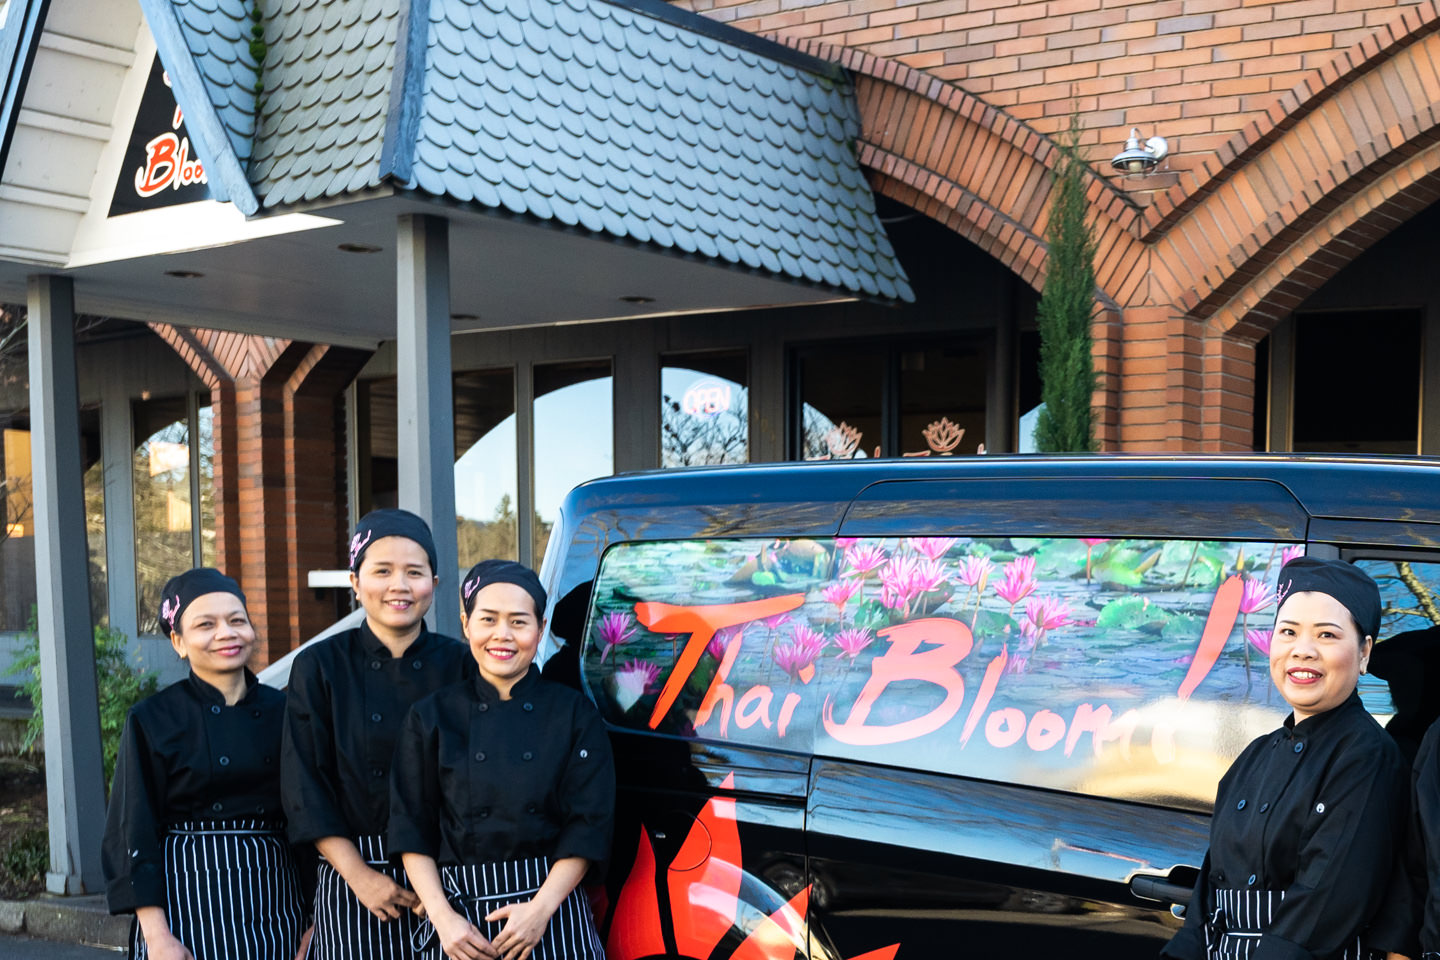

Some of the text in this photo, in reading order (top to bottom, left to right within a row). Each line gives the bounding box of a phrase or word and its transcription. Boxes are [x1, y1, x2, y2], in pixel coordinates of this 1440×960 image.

[135, 132, 207, 197] Bloo
[683, 385, 731, 416] OPEN
[634, 574, 1244, 764] Thai Bloom!
